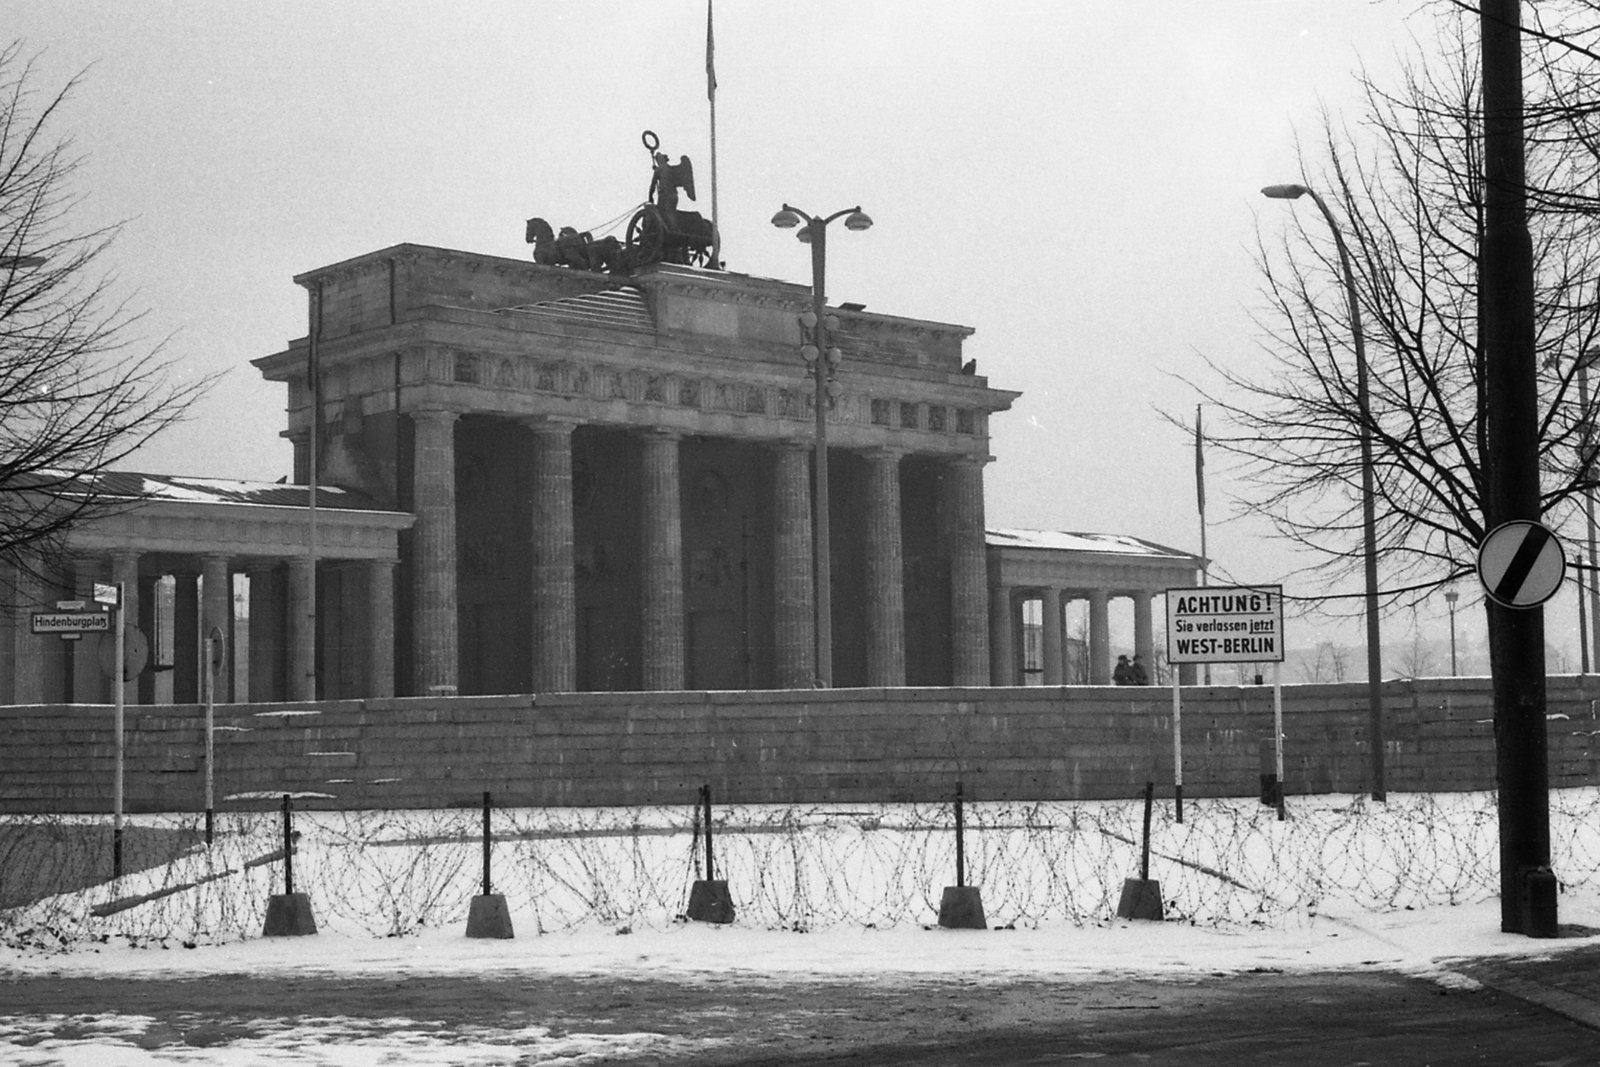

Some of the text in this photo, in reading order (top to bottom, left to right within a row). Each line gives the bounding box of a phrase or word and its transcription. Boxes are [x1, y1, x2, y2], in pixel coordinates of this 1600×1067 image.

[1176, 593, 1272, 613] ACHTUNG!
[35, 616, 107, 629] Hindenburgplatz
[1176, 618, 1274, 634] Sie verlassen jetzt
[1176, 637, 1274, 654] WEST-BERLIN
